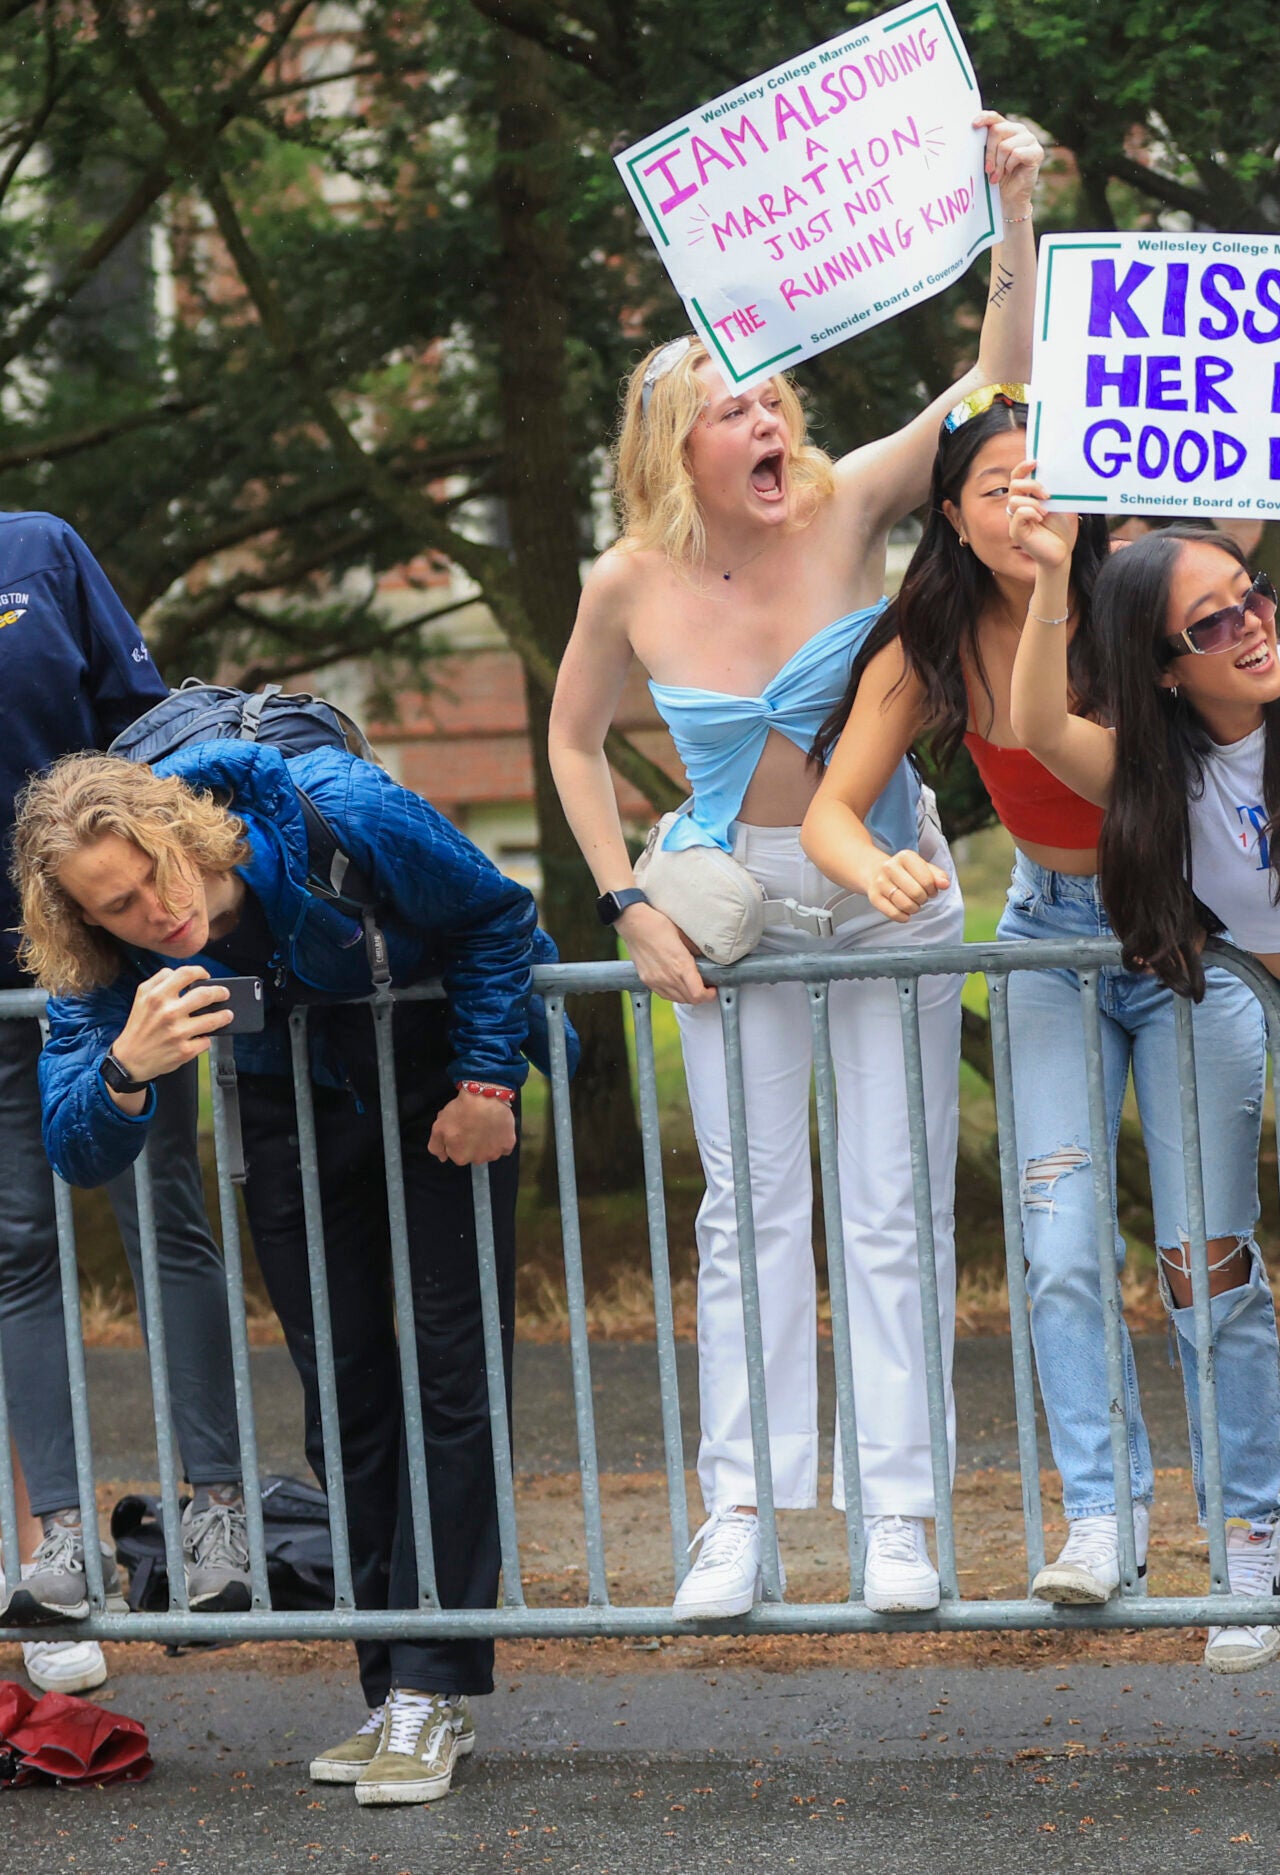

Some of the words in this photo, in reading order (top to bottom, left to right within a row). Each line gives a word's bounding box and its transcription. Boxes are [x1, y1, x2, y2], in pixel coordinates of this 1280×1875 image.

[700, 86, 765, 124] Wellesley
[767, 59, 816, 90] College
[819, 33, 870, 64] Marmon
[643, 148, 698, 215] I
[691, 115, 769, 185] AM
[775, 64, 867, 141] ALSO
[865, 28, 939, 88] DOING
[805, 137, 829, 161] A
[711, 116, 922, 252] MARATHON
[763, 208, 833, 261] JUST
[845, 175, 895, 226] NOT
[712, 304, 766, 343] THE
[779, 219, 914, 312] RUNNING
[919, 176, 976, 234] KIND!
[1137, 239, 1207, 255] Wellesley
[1212, 241, 1269, 256] College
[810, 307, 871, 344] Schneider
[873, 285, 910, 312] Board
[912, 280, 924, 294] of
[926, 258, 964, 286] Governors
[1085, 354, 1238, 414] HER
[1083, 418, 1247, 483] GOOD
[1119, 493, 1188, 508] Schneider
[1193, 496, 1233, 509] Board
[1238, 497, 1252, 509] of
[0, 592, 29, 606] GTON
